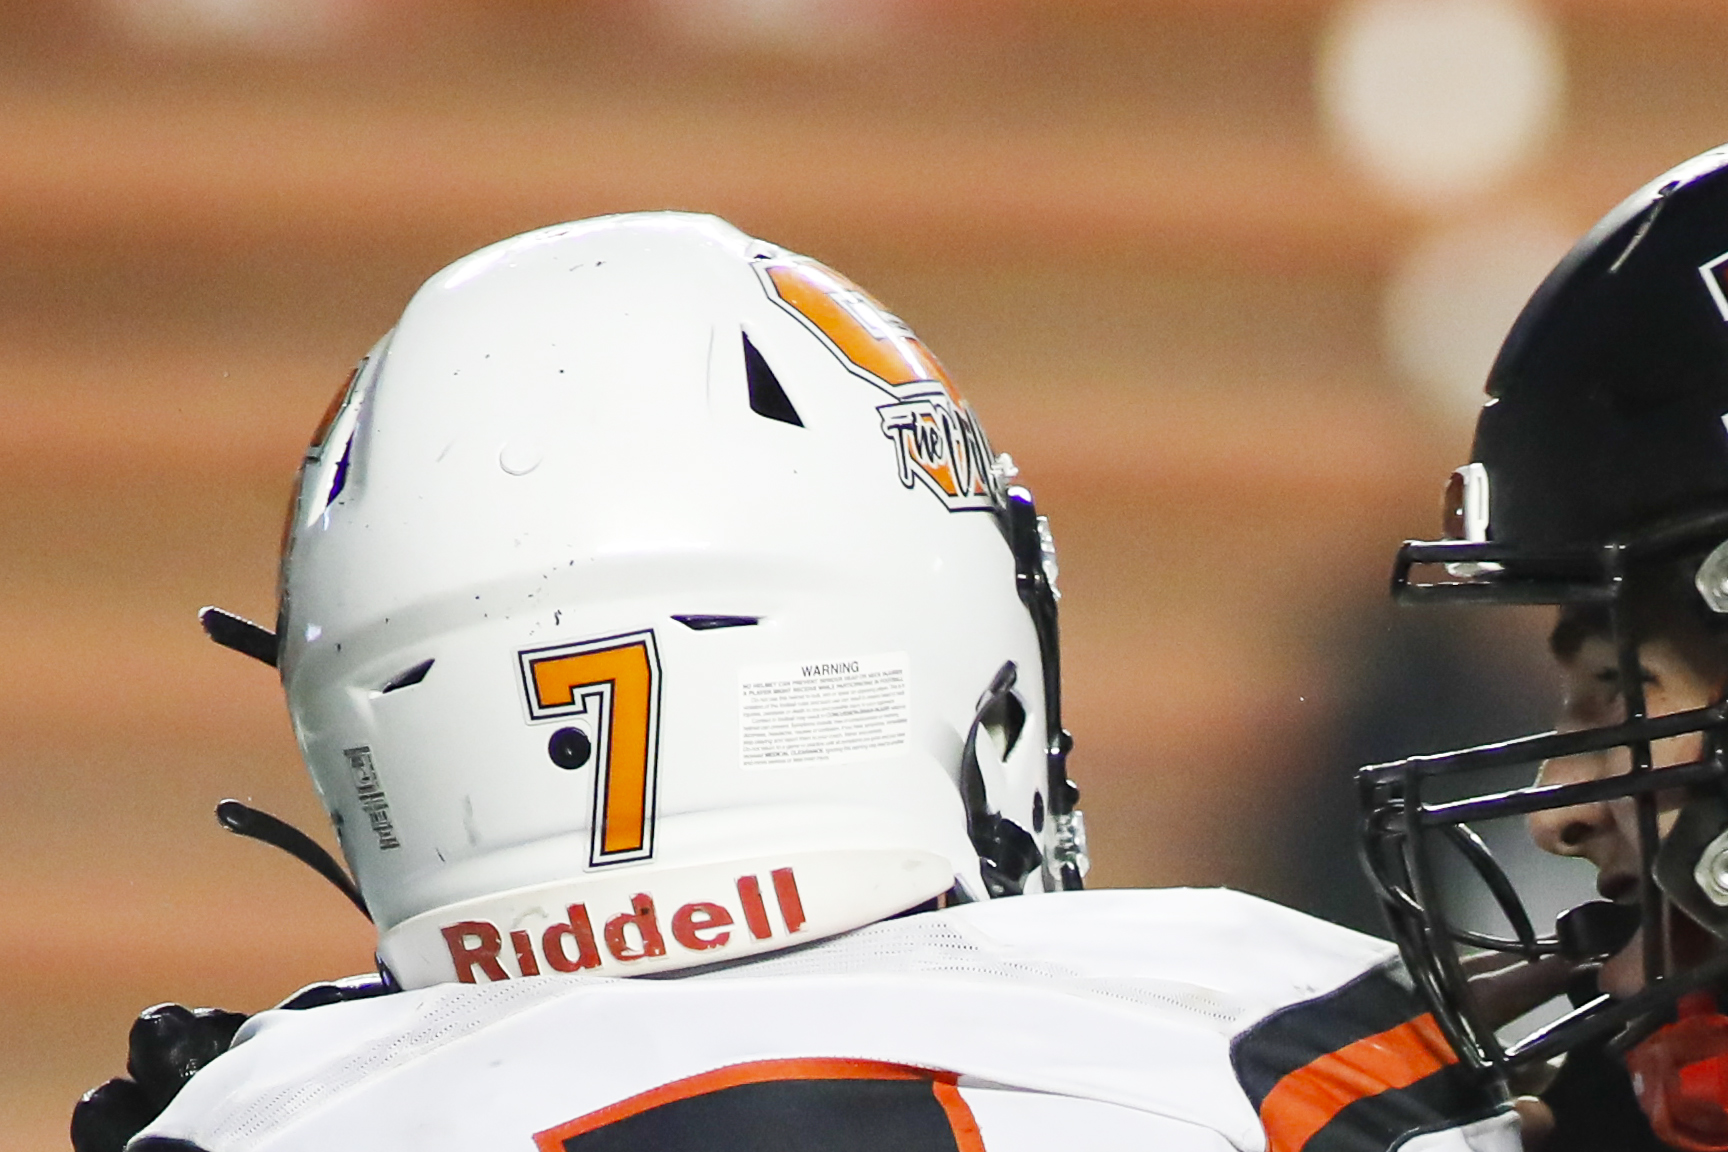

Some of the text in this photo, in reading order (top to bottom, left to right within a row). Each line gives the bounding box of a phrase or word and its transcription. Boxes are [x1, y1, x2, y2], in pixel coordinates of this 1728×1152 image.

[801, 660, 860, 677] WARNING
[517, 629, 663, 868] 7
[440, 867, 806, 984] Riddell
